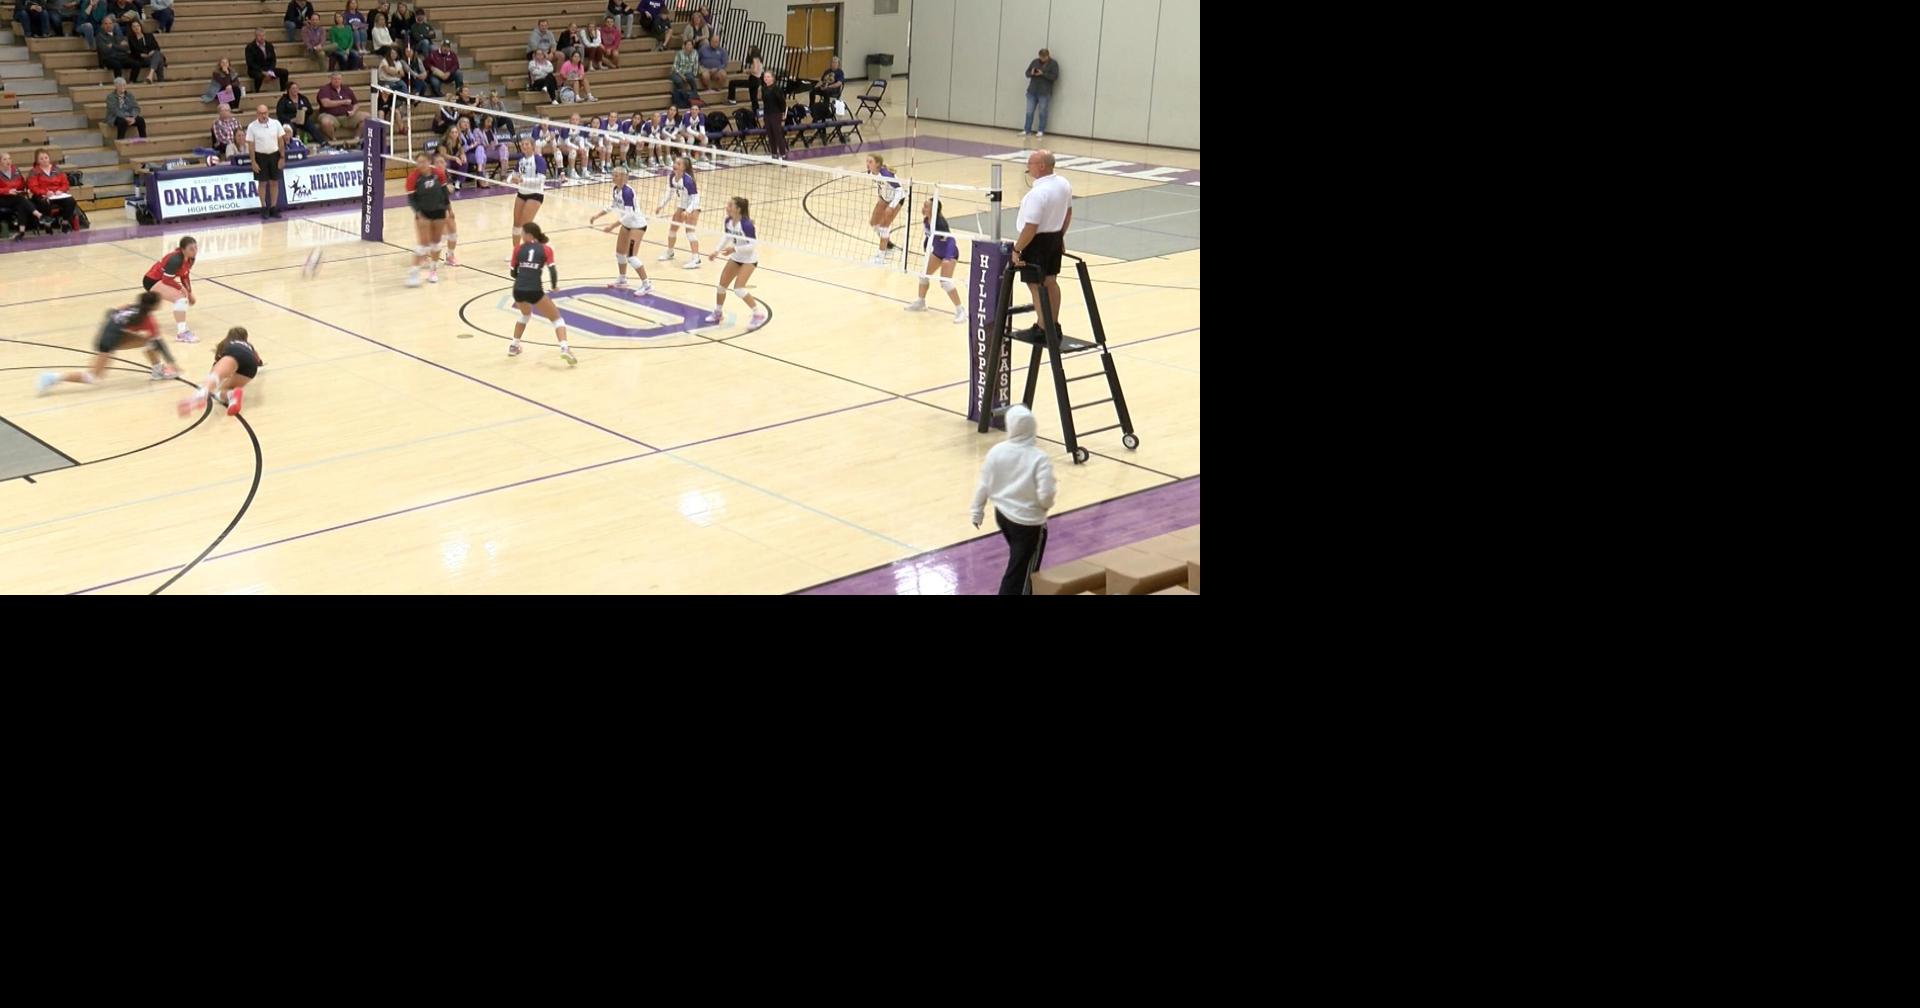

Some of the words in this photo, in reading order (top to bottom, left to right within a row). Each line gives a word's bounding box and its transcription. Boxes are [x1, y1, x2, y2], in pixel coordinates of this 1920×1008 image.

[309, 169, 364, 191] HILLTOPPE
[365, 128, 373, 233] HILLTOPPERS
[163, 180, 259, 207] ONALASKA
[187, 205, 208, 214] HIGH
[209, 201, 240, 211] SCHOOL
[528, 248, 535, 262] 1
